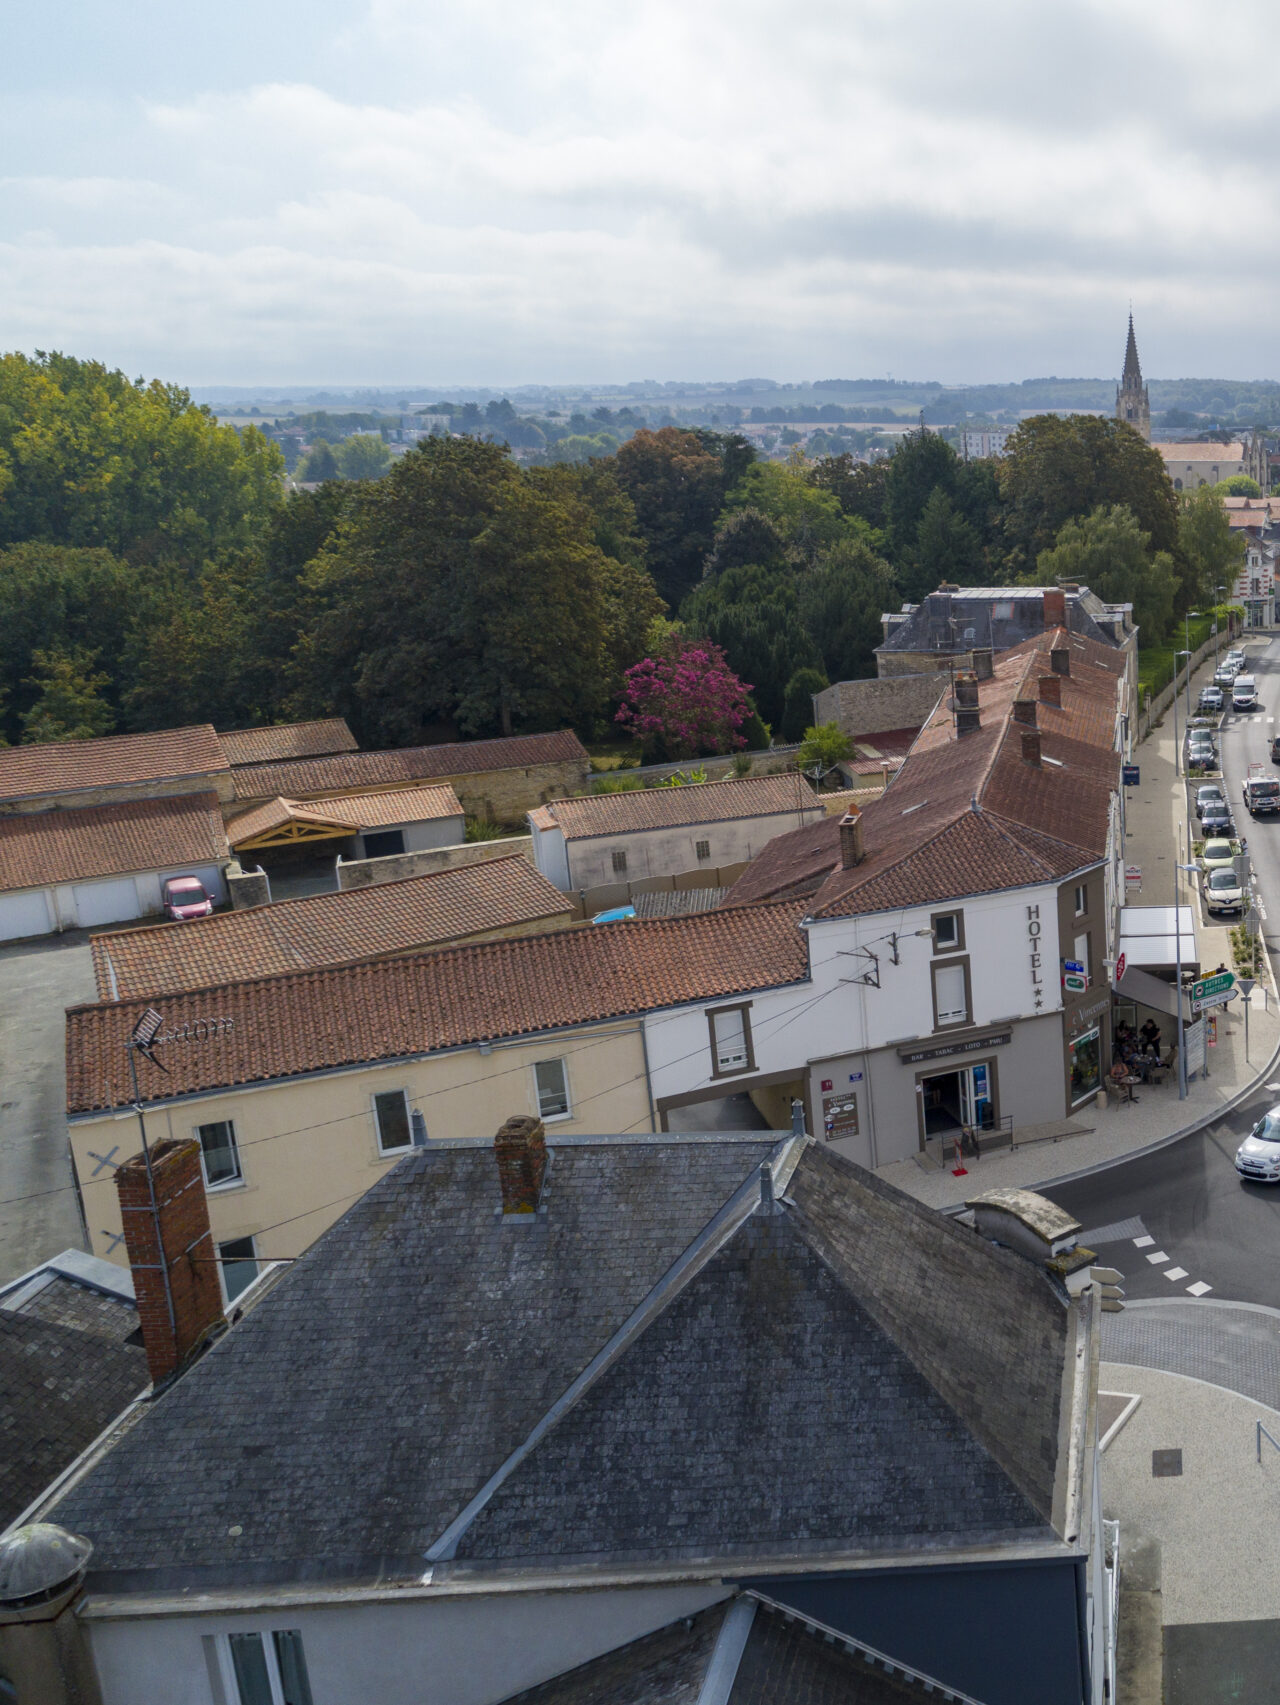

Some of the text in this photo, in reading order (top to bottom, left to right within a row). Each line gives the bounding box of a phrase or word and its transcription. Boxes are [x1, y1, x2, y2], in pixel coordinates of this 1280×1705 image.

[1026, 904, 1042, 985] HOTEL
[911, 1053, 924, 1061] BAR
[935, 1047, 954, 1056] TABAC
[965, 1042, 981, 1050] LOTO
